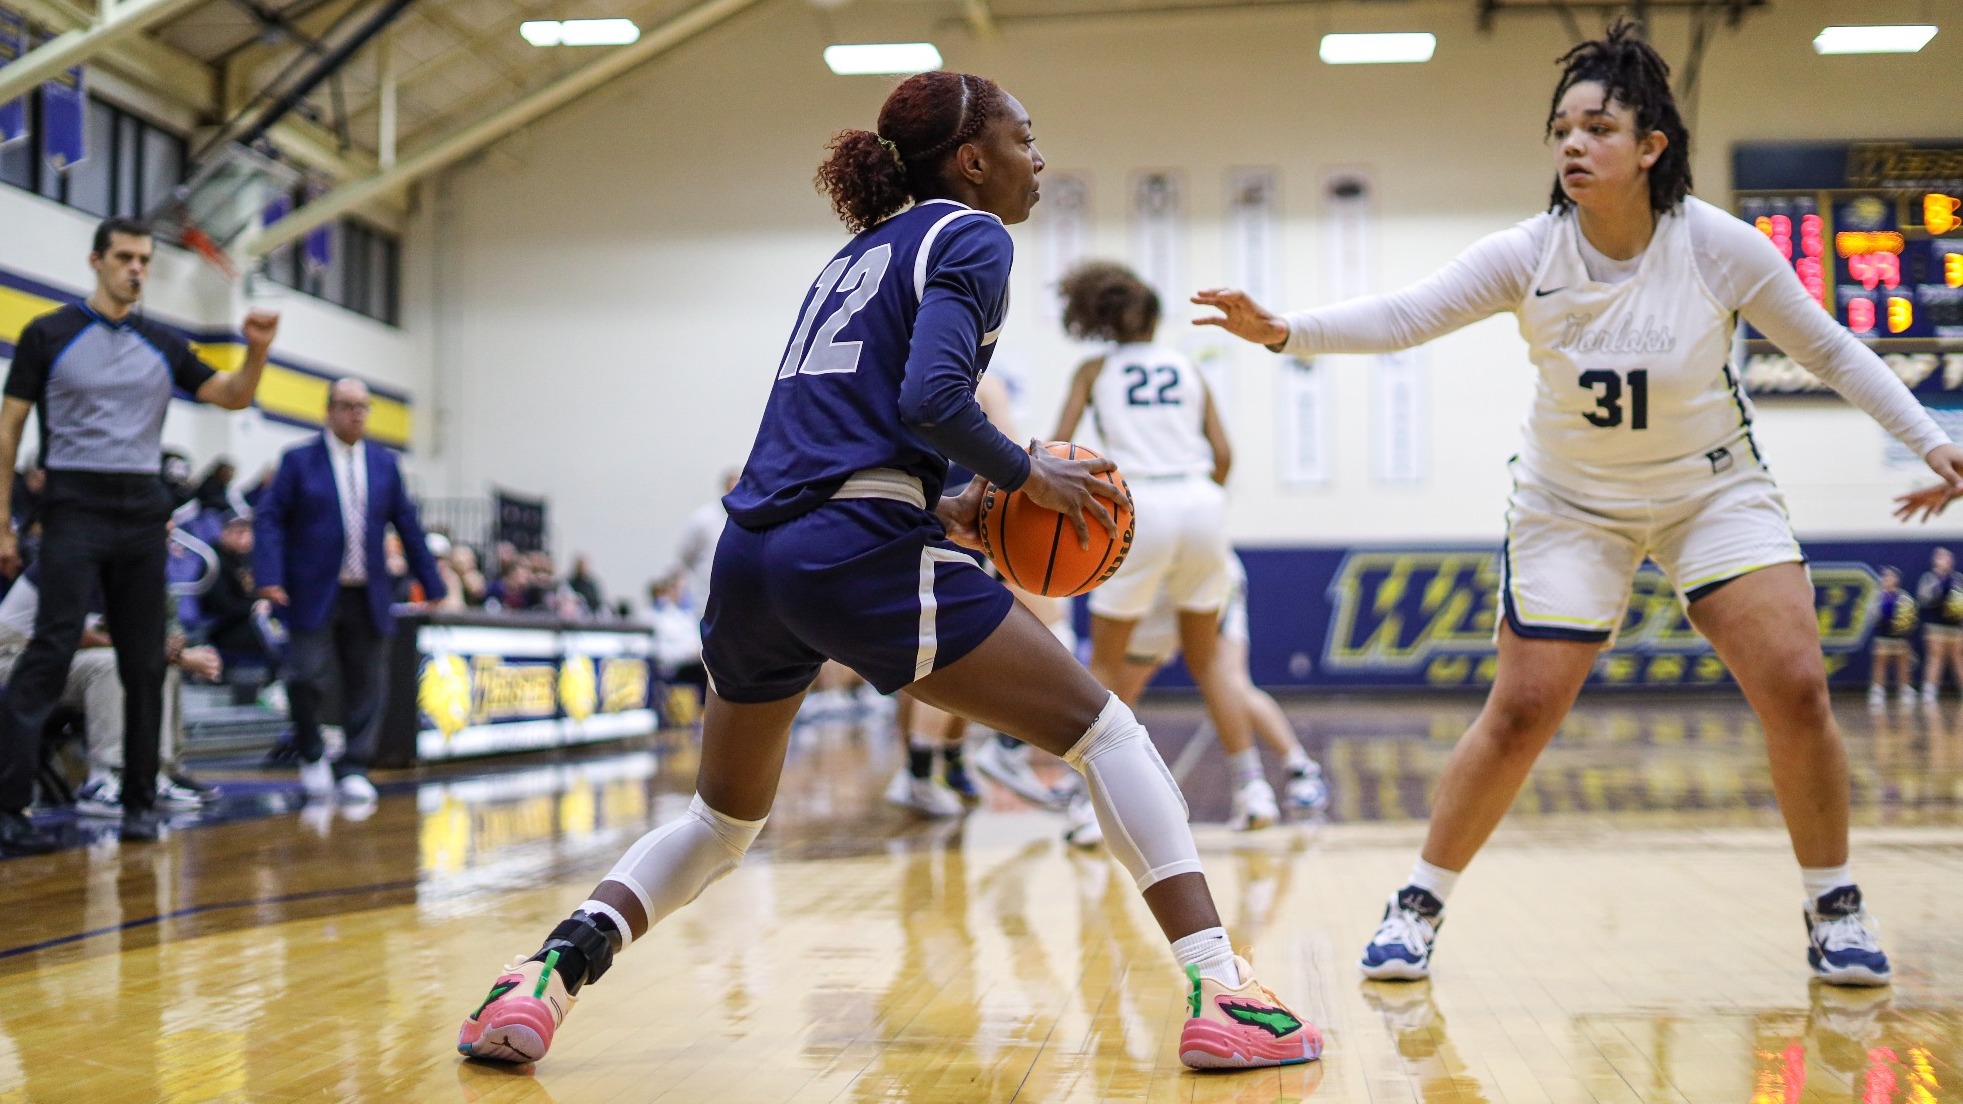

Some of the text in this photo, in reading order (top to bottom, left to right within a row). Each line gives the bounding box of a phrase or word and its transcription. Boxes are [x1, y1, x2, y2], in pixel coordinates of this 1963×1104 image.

[778, 243, 893, 380] 12
[1123, 364, 1182, 407] 22
[1578, 369, 1648, 430] 31
